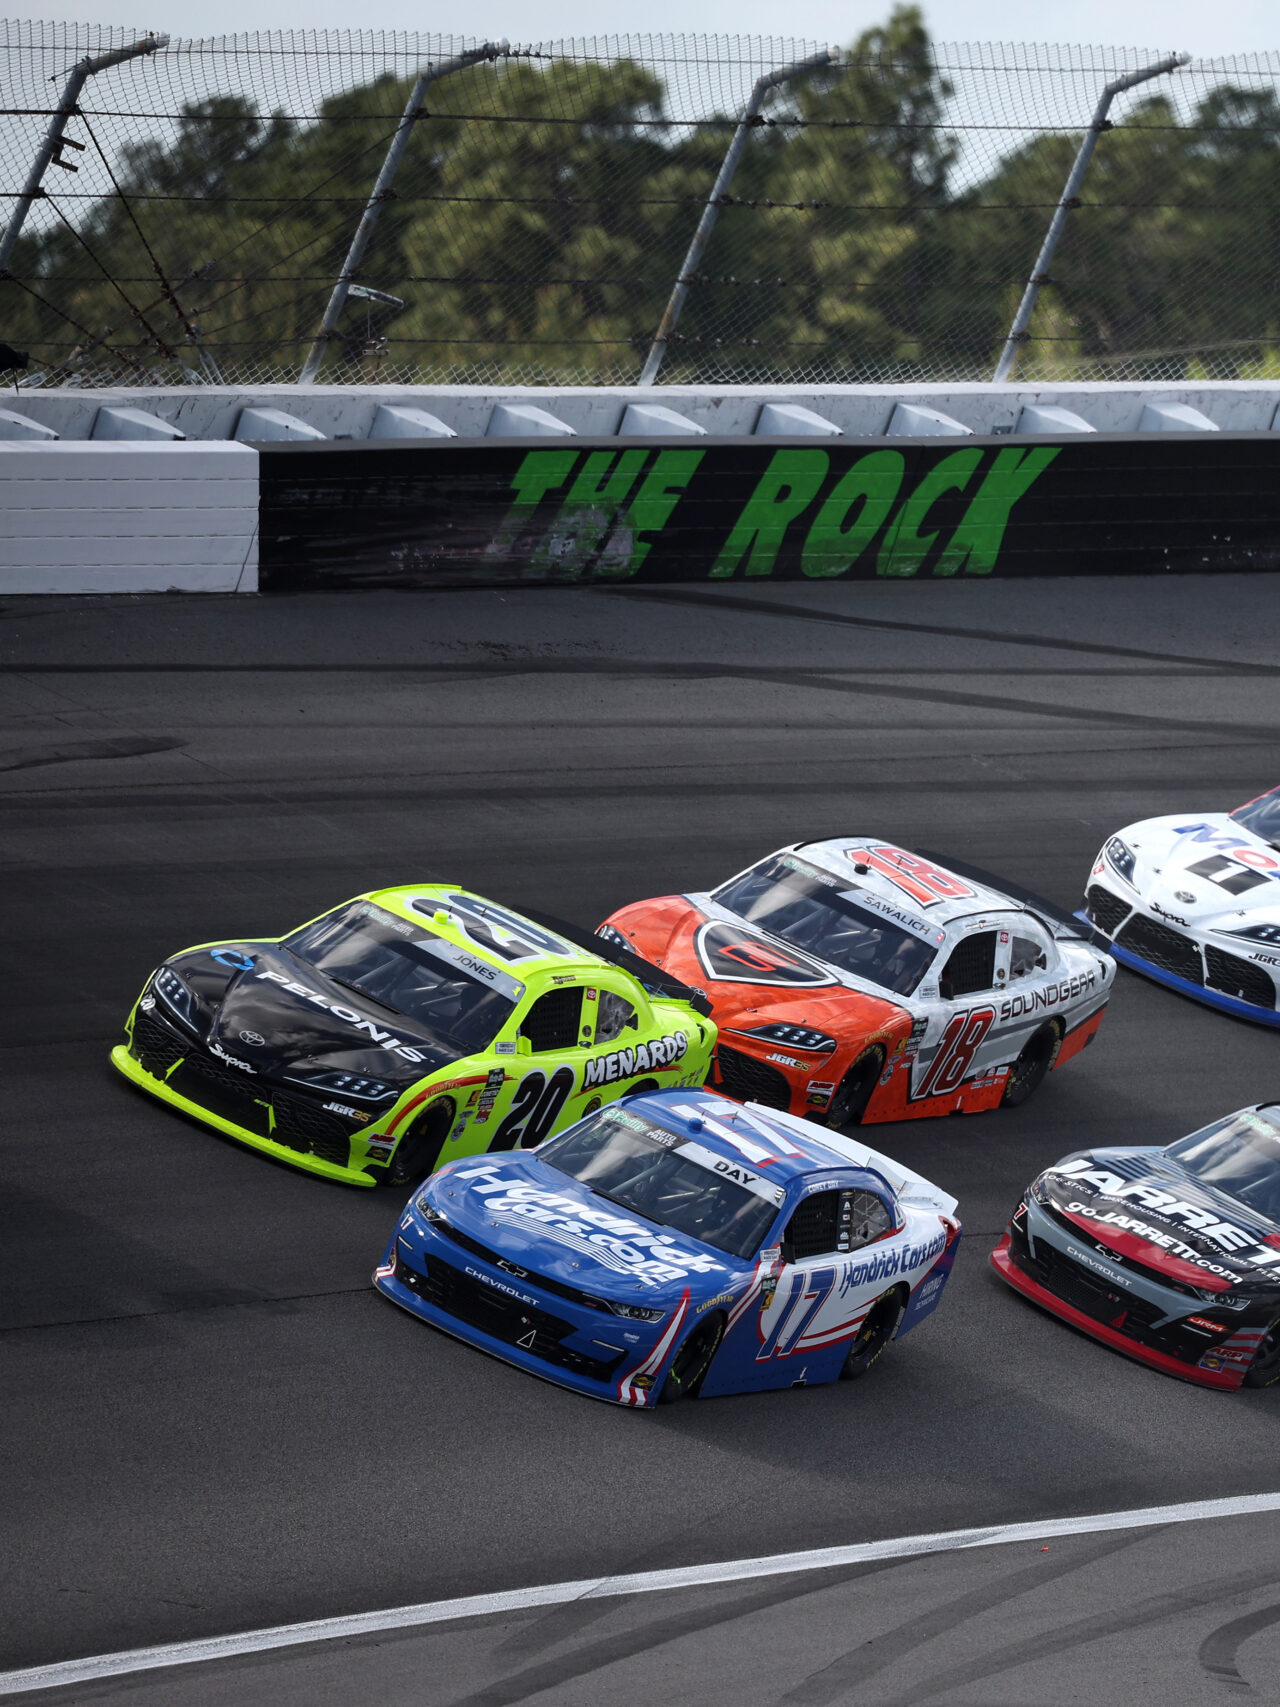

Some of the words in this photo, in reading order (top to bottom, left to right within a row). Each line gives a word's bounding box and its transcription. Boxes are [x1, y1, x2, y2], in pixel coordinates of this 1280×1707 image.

[501, 449, 707, 577] THE
[707, 447, 1063, 577] ROCK
[842, 845, 978, 910] 18
[403, 891, 578, 968] 20
[864, 895, 931, 935] SAWALICH
[452, 955, 497, 981] JONES
[256, 971, 427, 1062] PELONIS
[1000, 971, 1096, 1022] SOUNDGEAR
[209, 1044, 257, 1074] Supra
[581, 1031, 688, 1091] MENARDS
[911, 1005, 998, 1100] 18
[485, 1063, 576, 1153] 20
[646, 1131, 674, 1148] PARTS
[654, 1128, 678, 1142] AUTO
[667, 1101, 810, 1168] 17
[714, 1160, 759, 1184] DAY
[400, 1214, 414, 1231] 17
[454, 1165, 727, 1274] Hendrick
[1014, 1202, 1029, 1220] 7
[484, 1197, 690, 1283] Cars.com
[1065, 1201, 1244, 1284] goJARRETT.com
[1177, 1225, 1248, 1269] INTERNATIONAL
[464, 1266, 540, 1306] CHEVROLET
[838, 1248, 900, 1299] Hendrick
[1067, 1246, 1132, 1286] CHEVROLET
[696, 1294, 734, 1313] GOODYEAR
[754, 1265, 838, 1363] 17
